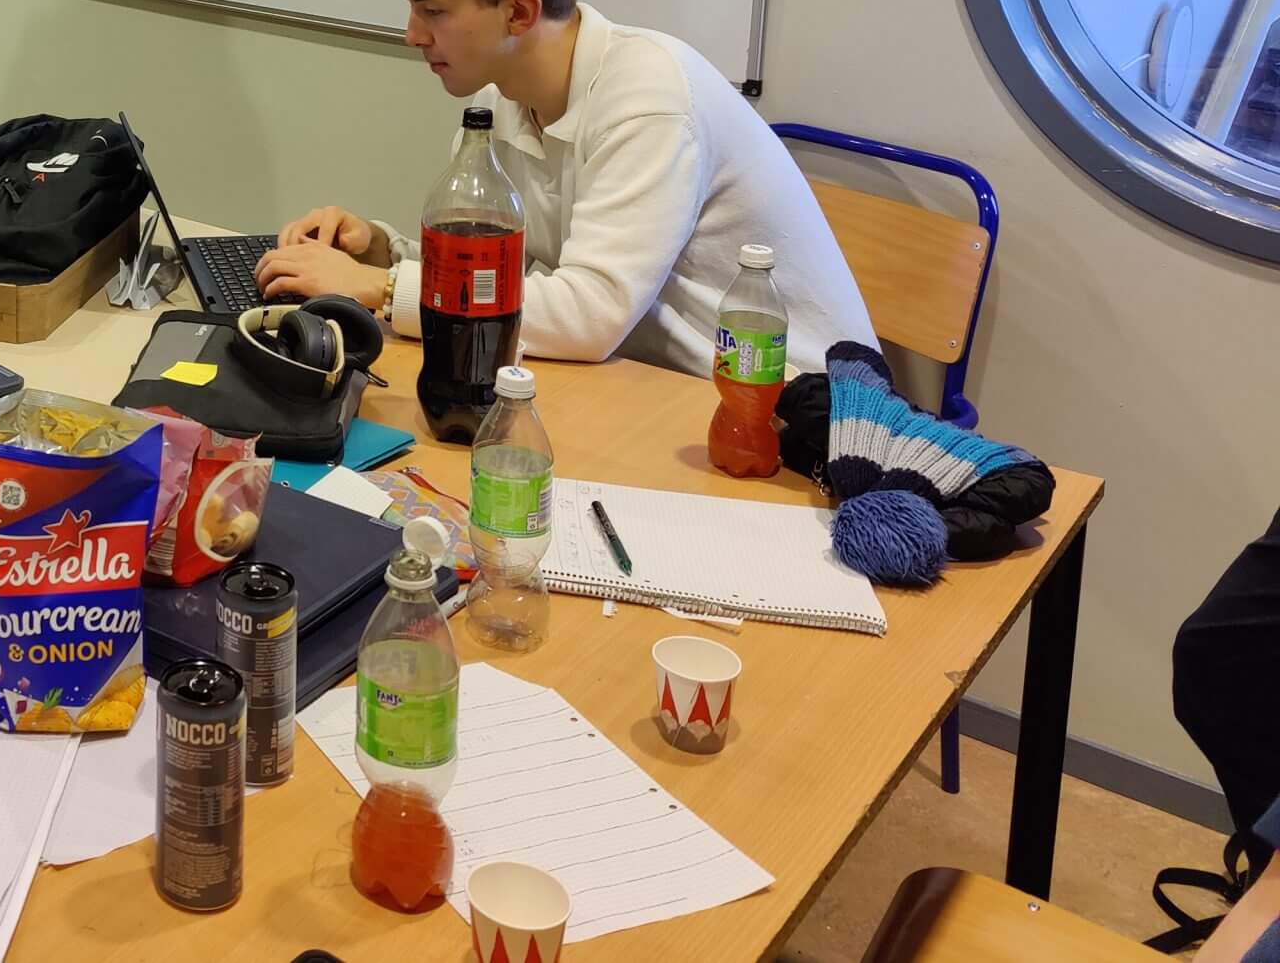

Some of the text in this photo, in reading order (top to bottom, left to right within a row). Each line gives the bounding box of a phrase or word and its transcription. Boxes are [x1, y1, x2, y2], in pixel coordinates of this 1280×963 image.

[216, 598, 253, 635] OCCO
[8, 639, 113, 664] & ONION
[166, 713, 226, 745] NOCCO
